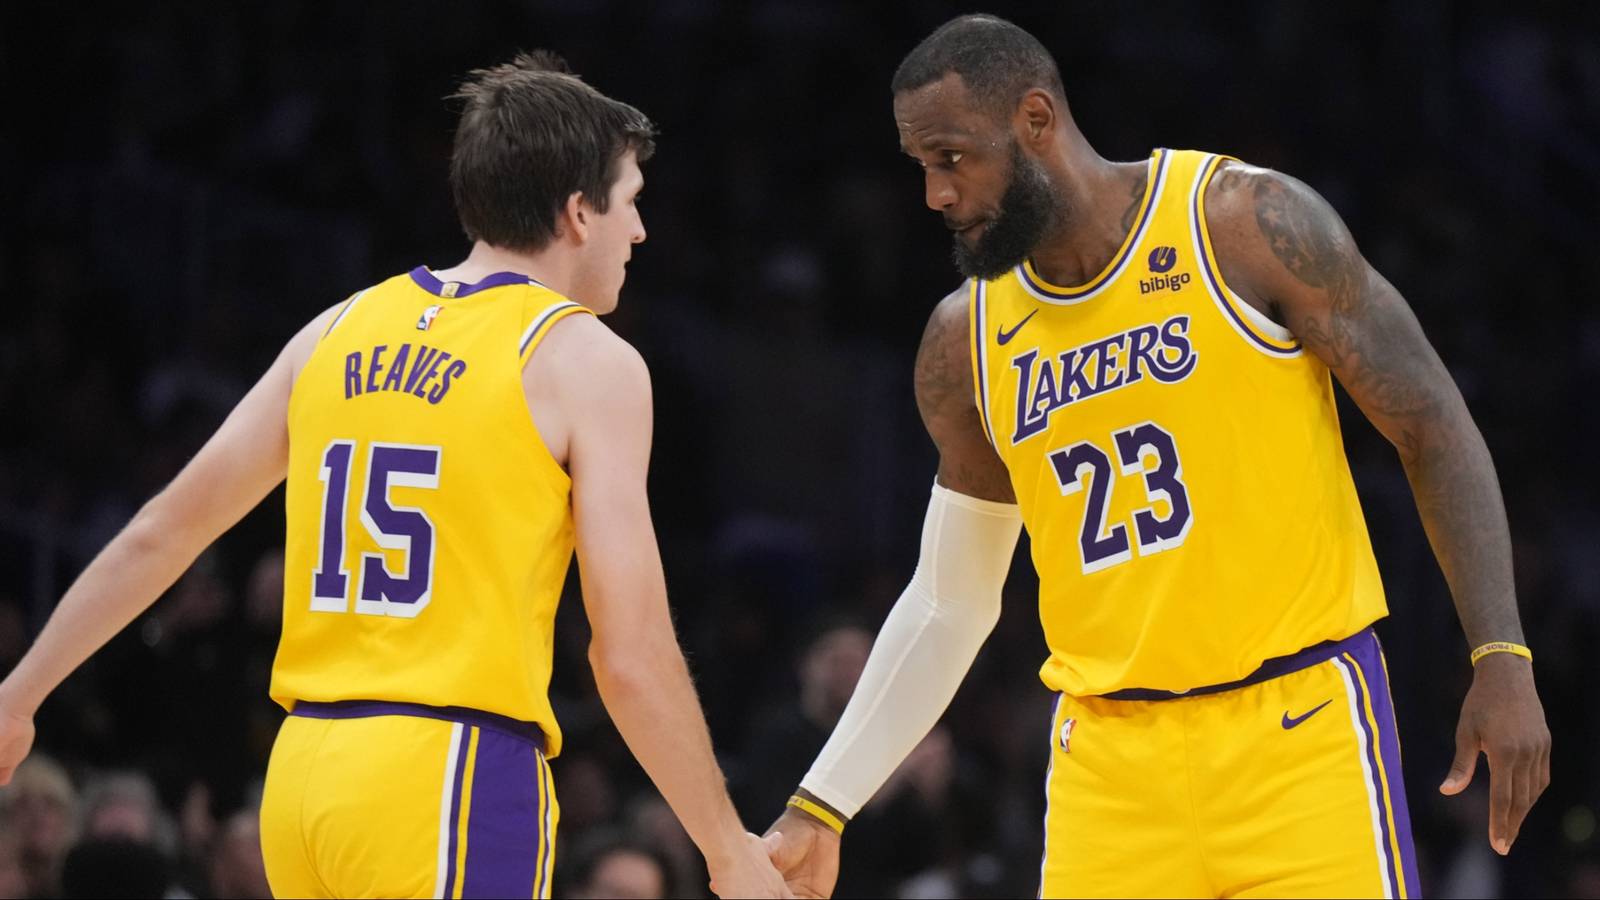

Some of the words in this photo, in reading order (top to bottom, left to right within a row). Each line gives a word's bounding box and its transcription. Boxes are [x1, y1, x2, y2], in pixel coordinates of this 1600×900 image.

[1139, 272, 1191, 294] bibigo
[345, 344, 466, 405] REAVES
[1012, 315, 1199, 446] LAKERS
[309, 438, 442, 618] 15
[1047, 420, 1194, 575] 23
